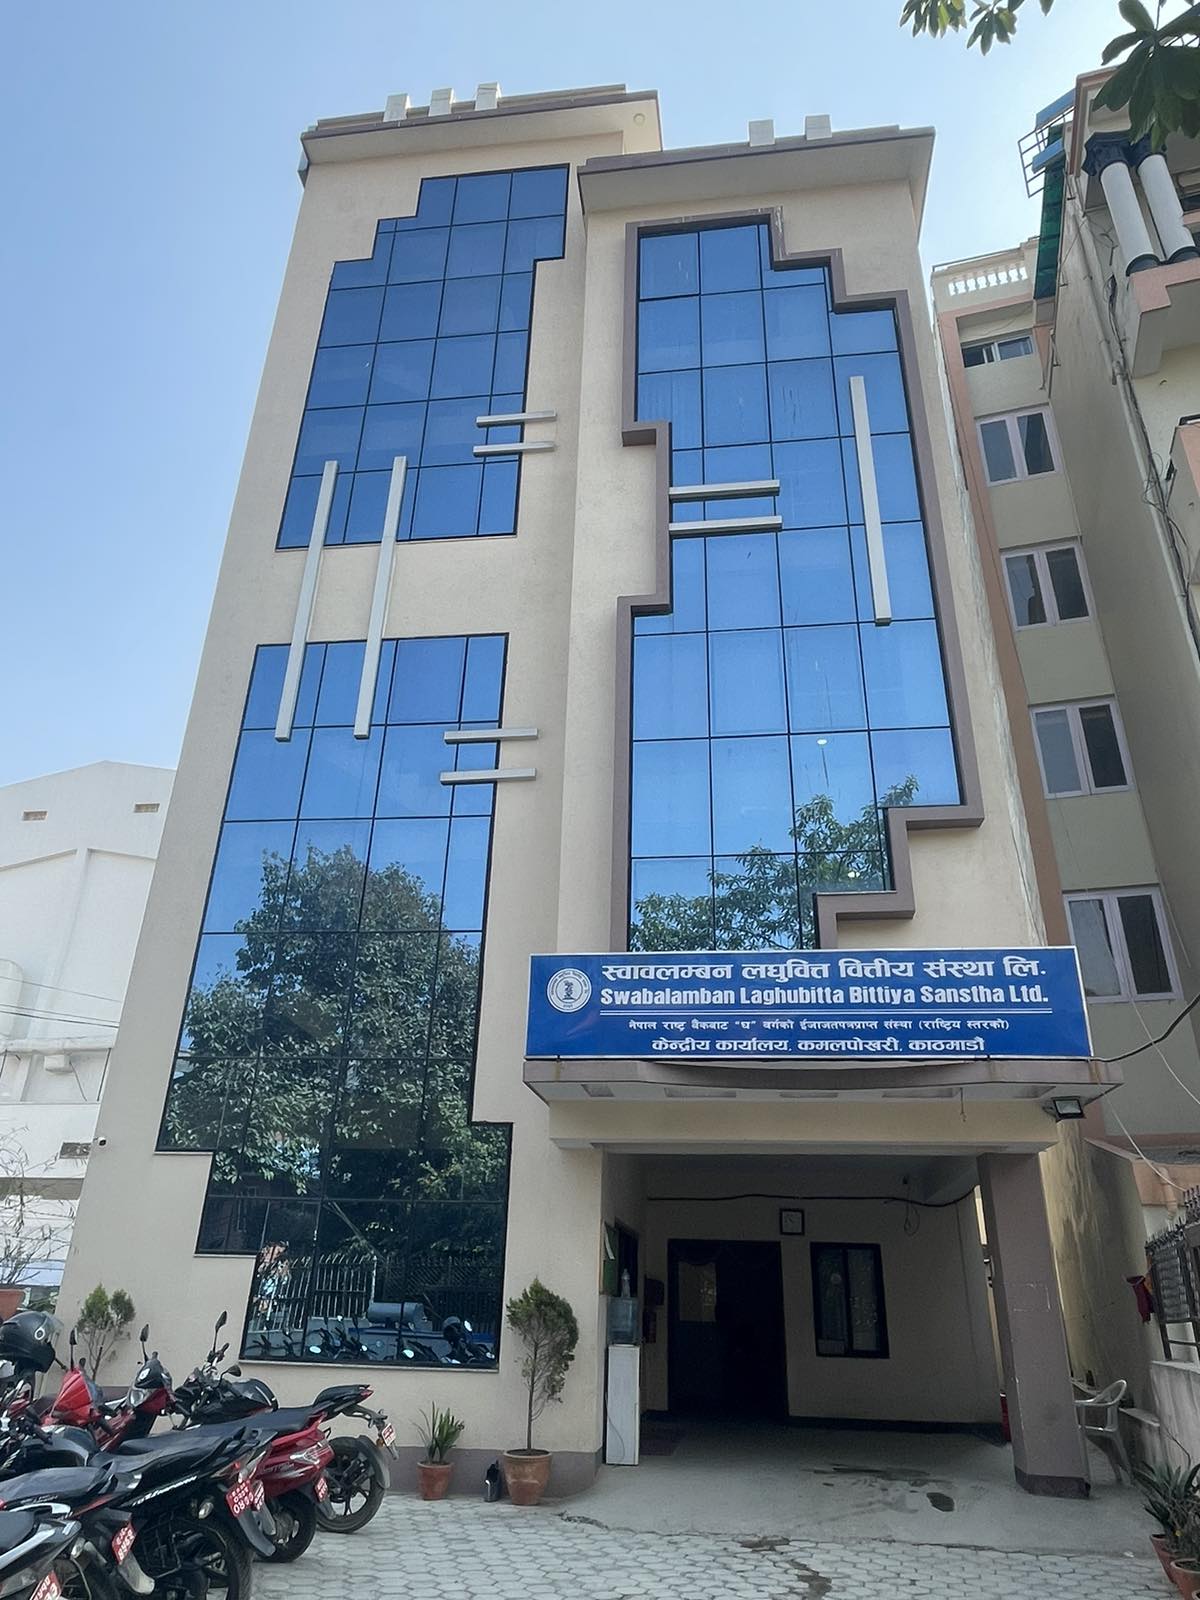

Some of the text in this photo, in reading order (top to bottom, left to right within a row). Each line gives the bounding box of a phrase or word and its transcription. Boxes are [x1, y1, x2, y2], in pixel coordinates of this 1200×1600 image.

[602, 955, 1047, 983] स्वावलम्बन लघुवित्त वित्तीय संस्था लि.
[600, 987, 735, 1005] Swabalamban
[740, 986, 844, 1005] Laghubitta
[849, 985, 916, 1005] Bittiya
[920, 985, 1005, 1004] Sanstha
[1009, 984, 1049, 1003] Ltd.
[629, 1019, 657, 1030] नेपाल
[662, 1020, 686, 1032] राष्ट्र
[884, 1019, 912, 1030] संस्था
[967, 1018, 1009, 1030] स्तरको)
[652, 1037, 711, 1052] केन्द्रीय
